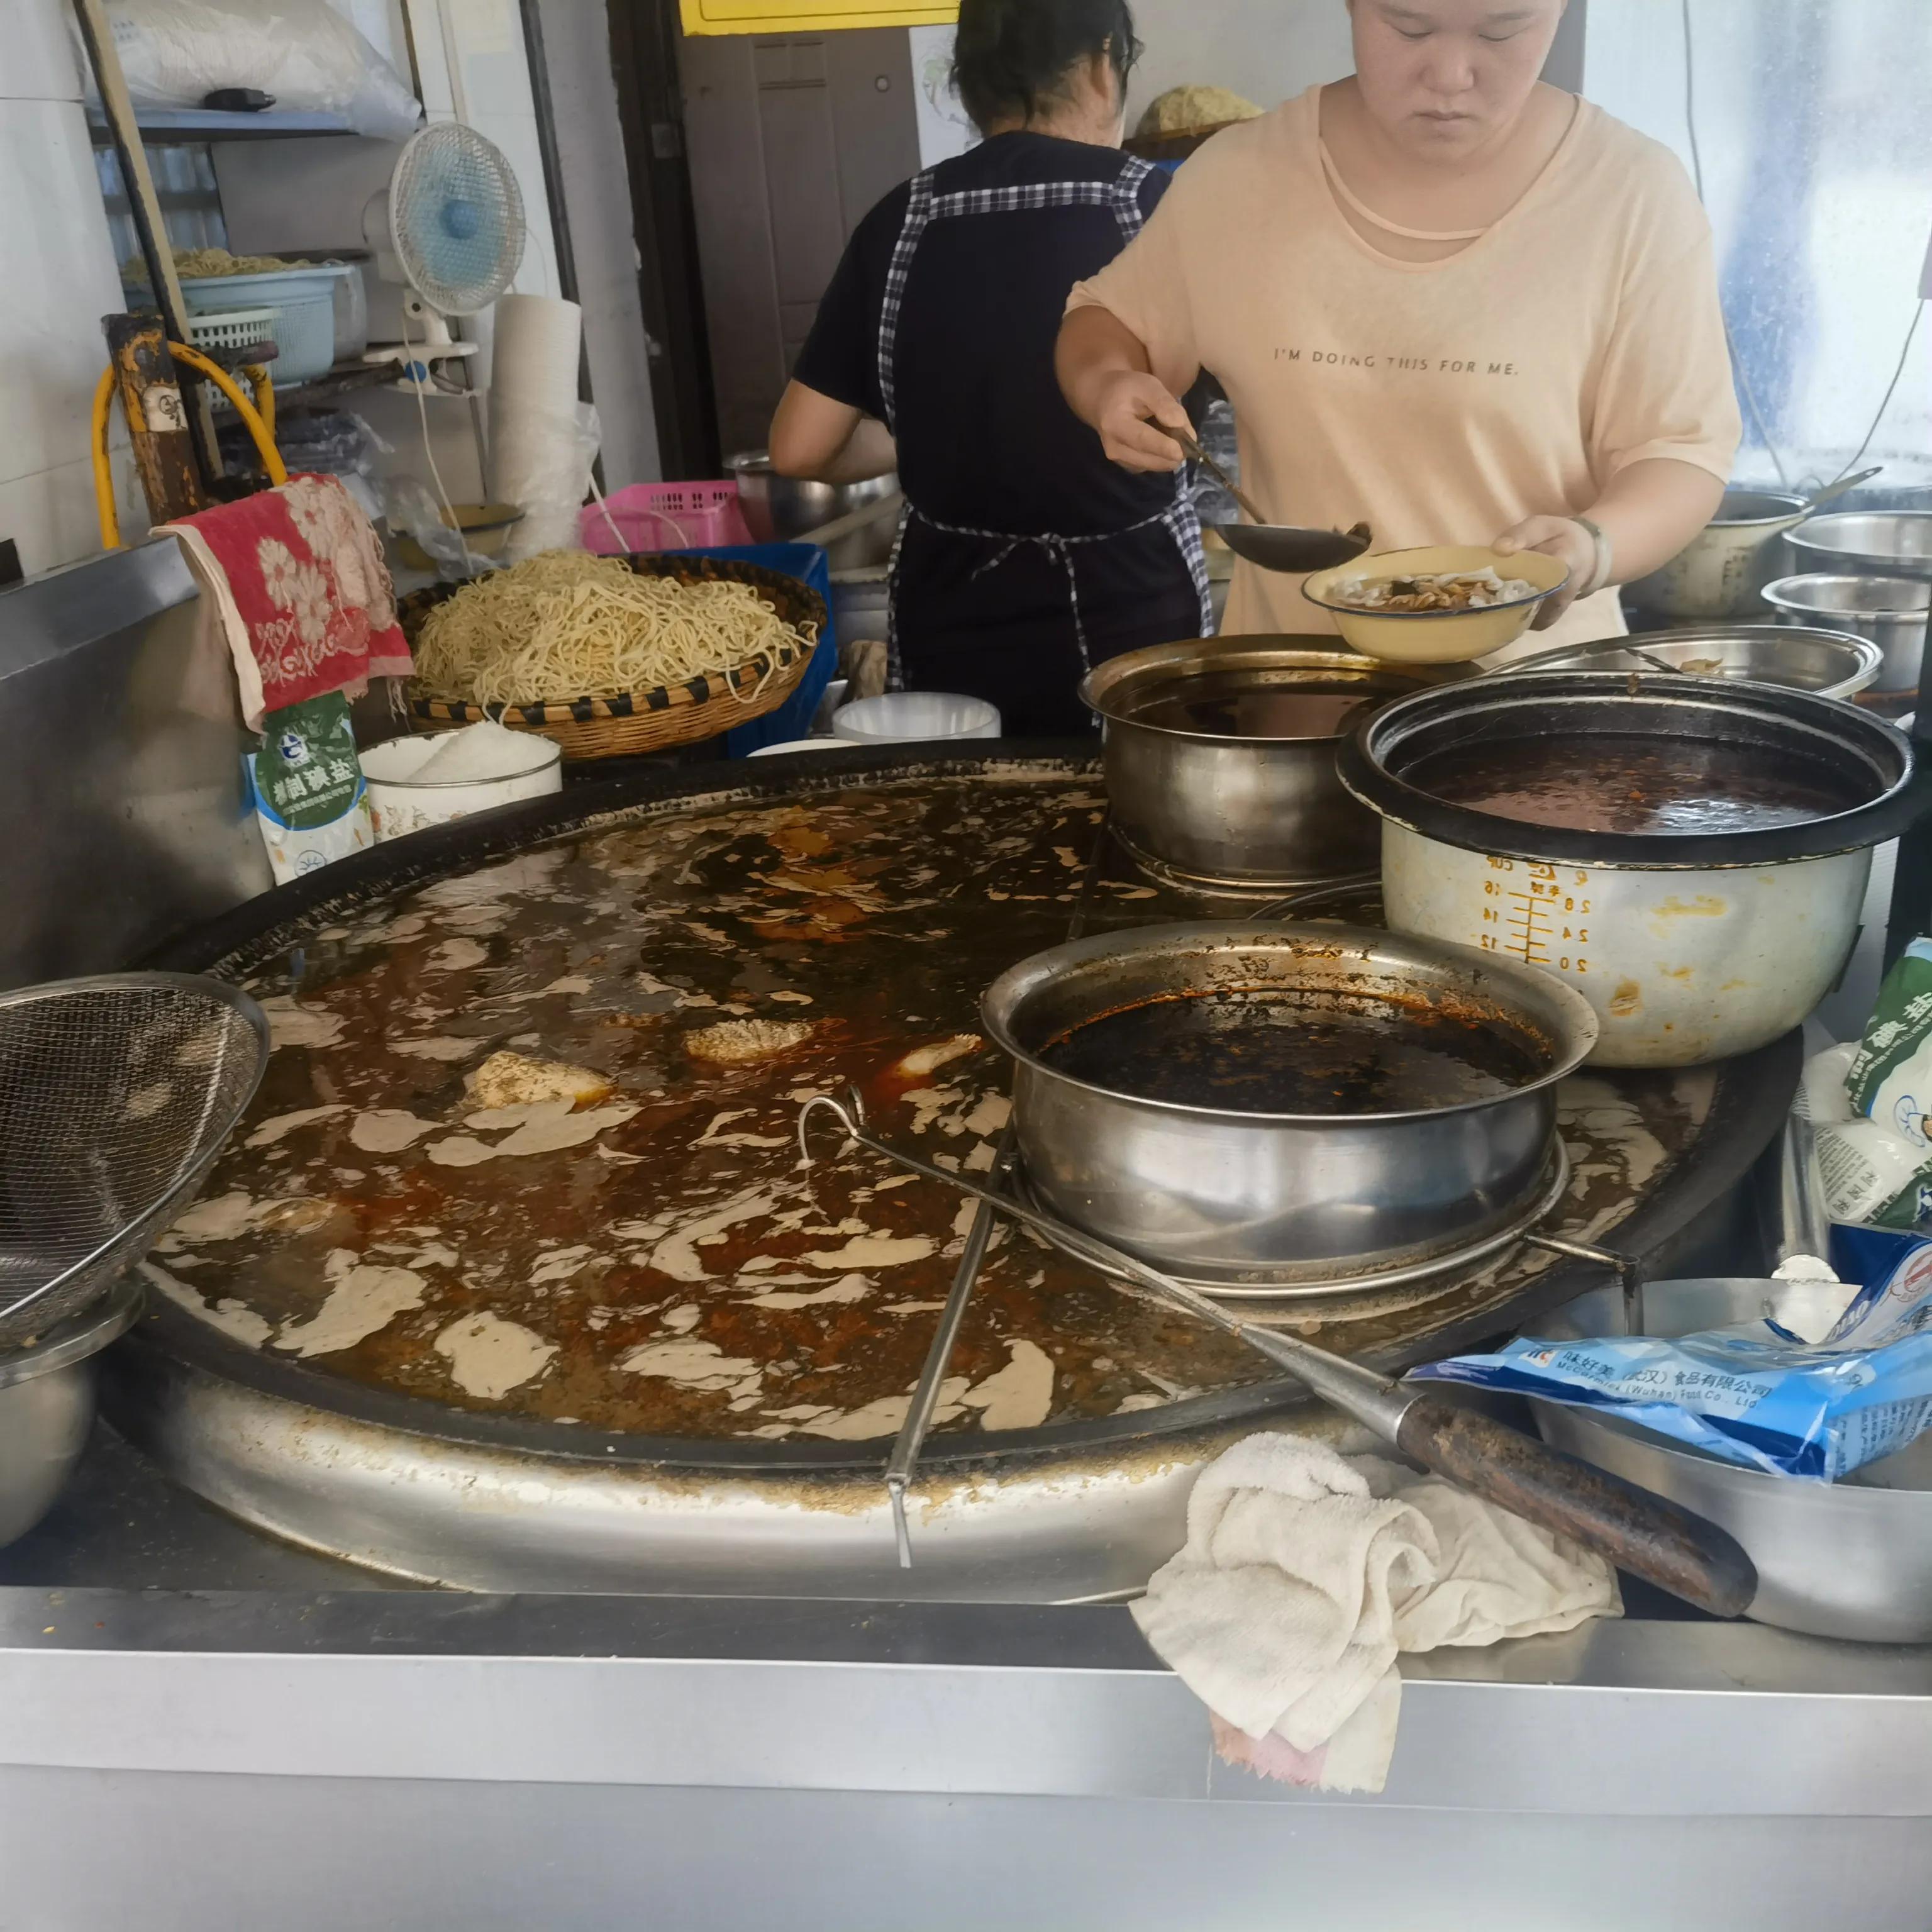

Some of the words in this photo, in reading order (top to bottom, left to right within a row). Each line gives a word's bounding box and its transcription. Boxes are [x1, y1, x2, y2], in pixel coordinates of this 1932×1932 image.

[1274, 348, 1300, 361] I'M
[1312, 350, 1375, 367] DOING
[1386, 357, 1428, 370] THIS
[1439, 359, 1476, 373] FOR
[1487, 362, 1519, 376] ME.
